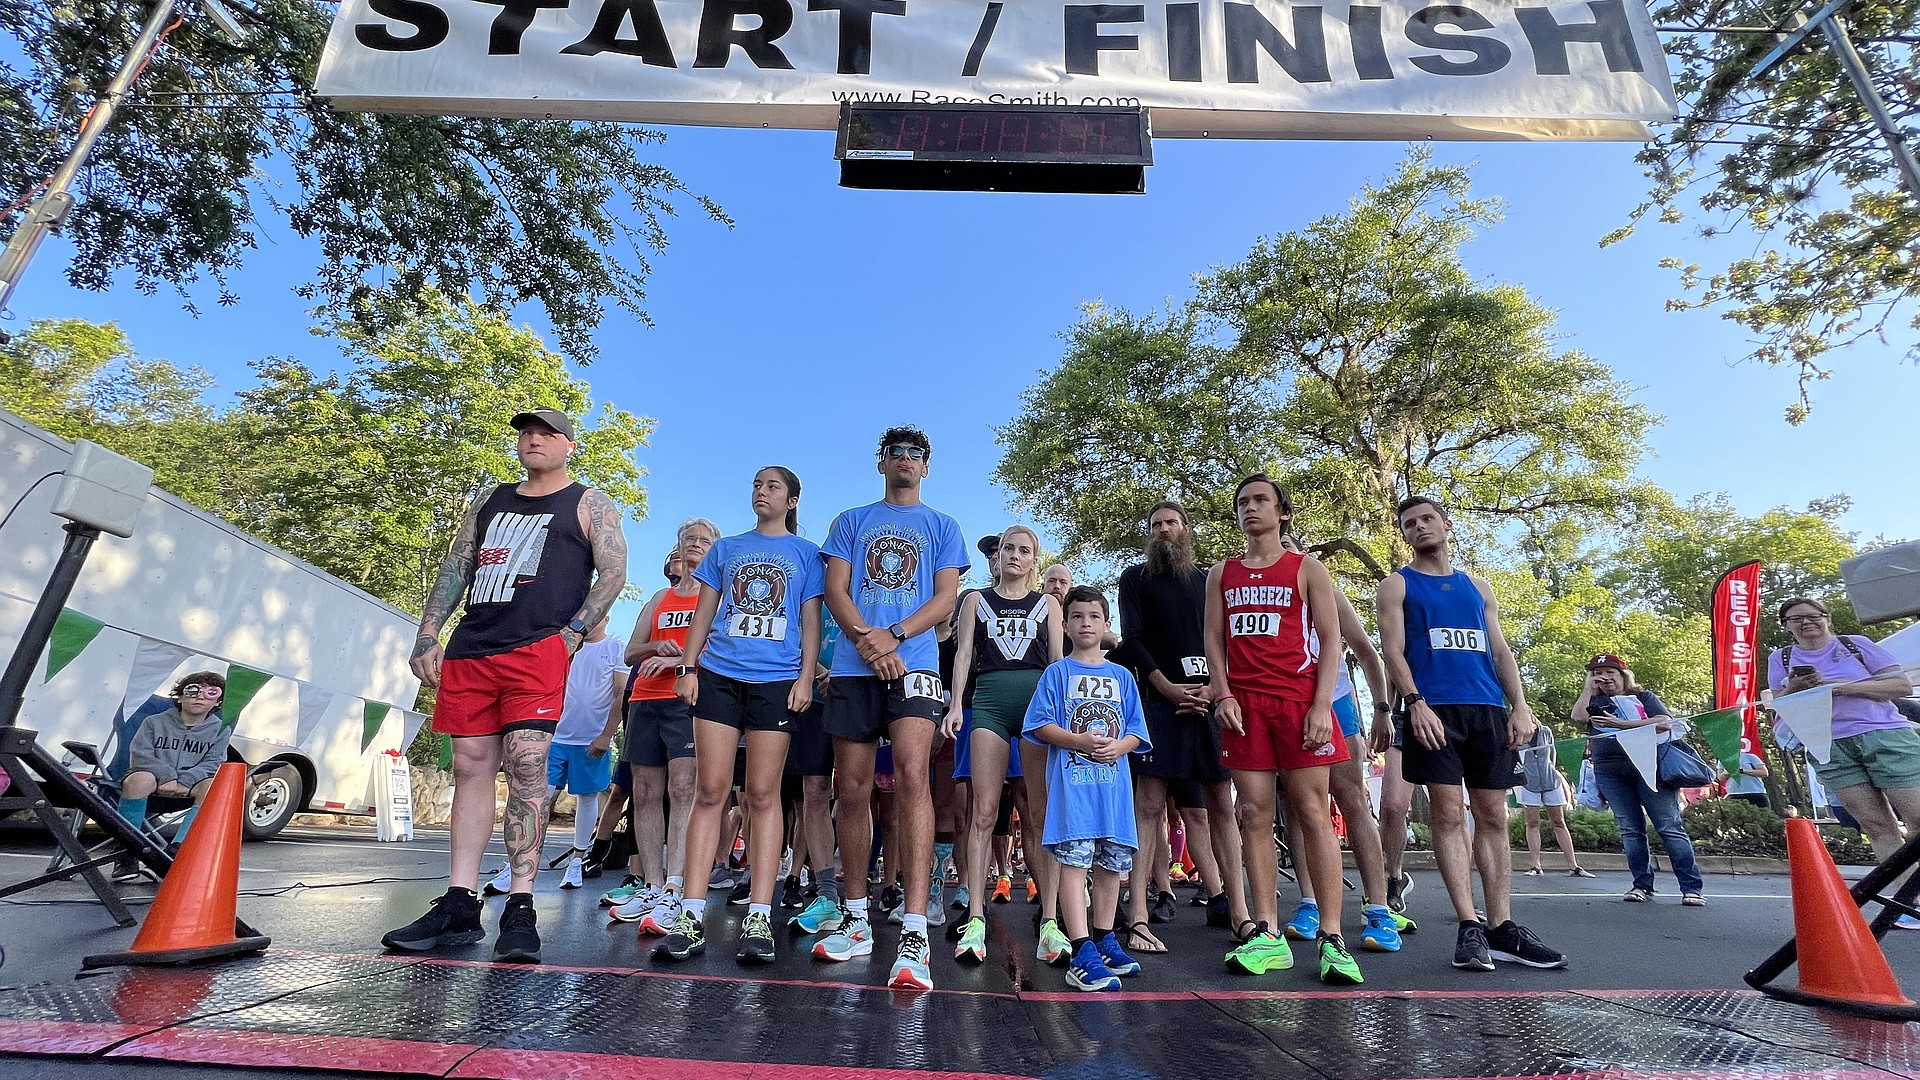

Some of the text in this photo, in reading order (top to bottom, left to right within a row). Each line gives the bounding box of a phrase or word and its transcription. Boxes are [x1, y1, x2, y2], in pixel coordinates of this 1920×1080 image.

[354, 0, 907, 75] START
[1064, 0, 1645, 83] FINISH
[831, 89, 1139, 107] wwwRaceSmithcom
[872, 540, 916, 558] DONUT
[737, 565, 784, 582] DONUT
[876, 569, 907, 584] DASH
[740, 596, 774, 612] DASH
[883, 591, 914, 608] RUN
[665, 611, 694, 627] 304
[738, 615, 775, 639] 431
[996, 619, 1028, 637] 544
[1234, 613, 1270, 634] 490
[1440, 629, 1478, 649] 306
[913, 674, 943, 700] 430
[1077, 676, 1113, 700] 425
[1074, 704, 1118, 727] DONUT
[154, 736, 214, 754] OLD NAVY
[1071, 768, 1094, 784] 5K
